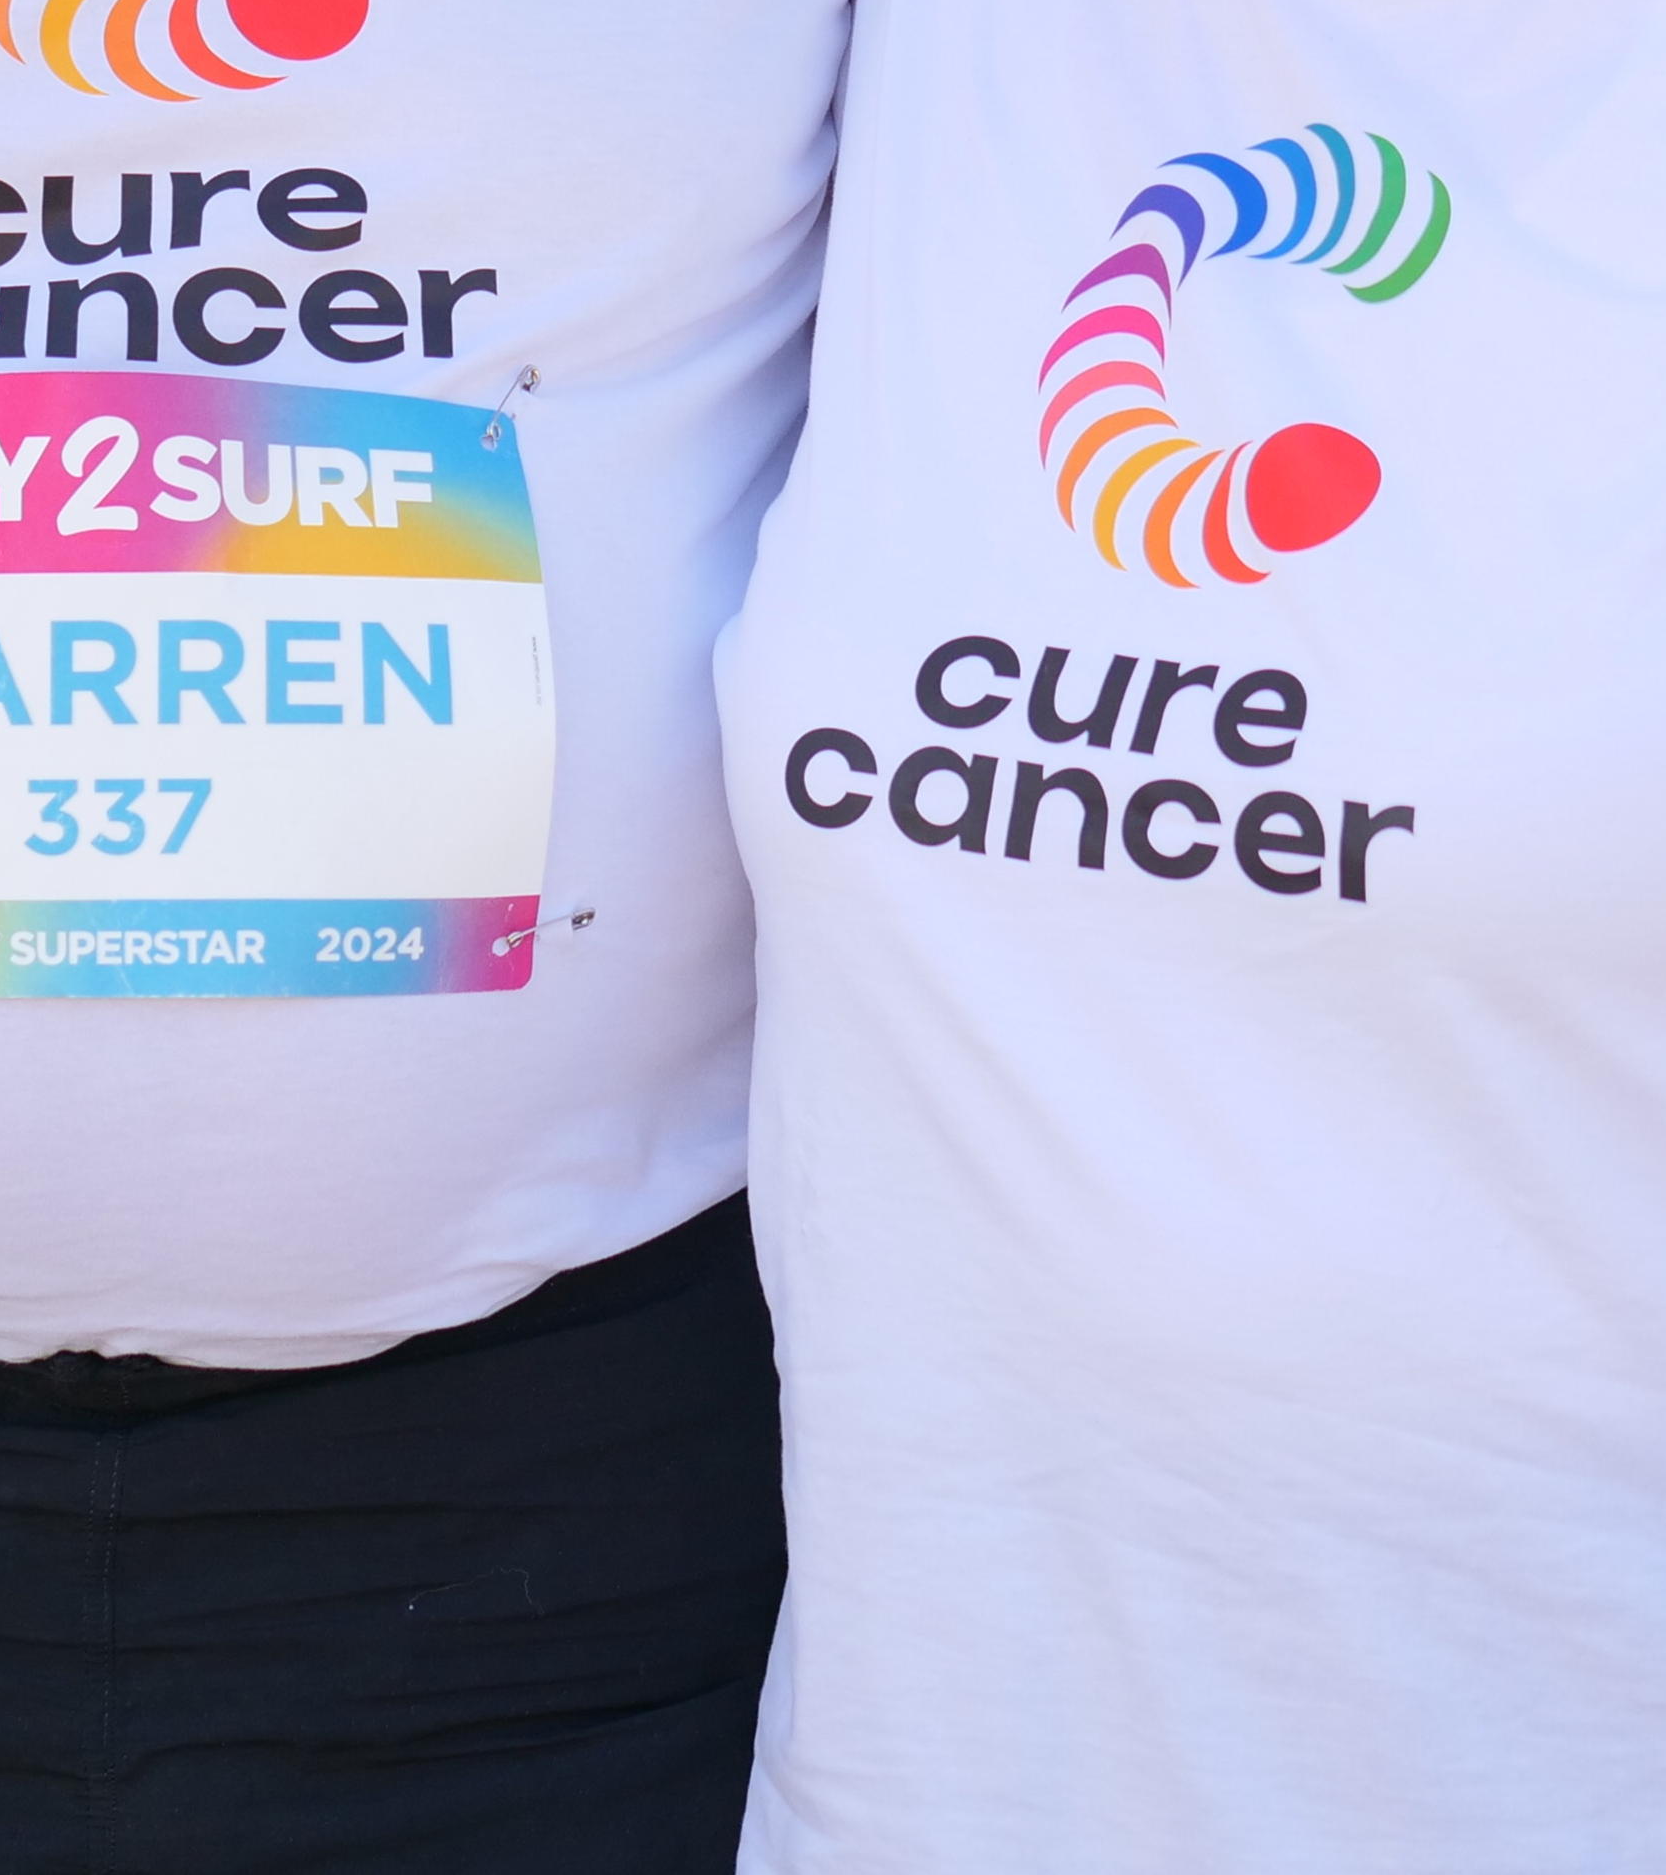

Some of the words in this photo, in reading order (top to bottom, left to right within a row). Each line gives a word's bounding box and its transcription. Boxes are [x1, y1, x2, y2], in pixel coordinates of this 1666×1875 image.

[914, 634, 1308, 768] cure
[23, 777, 214, 857] 337
[783, 727, 1416, 904] cancer
[9, 929, 266, 966] SUPERSTAR
[315, 926, 426, 962] 2024
